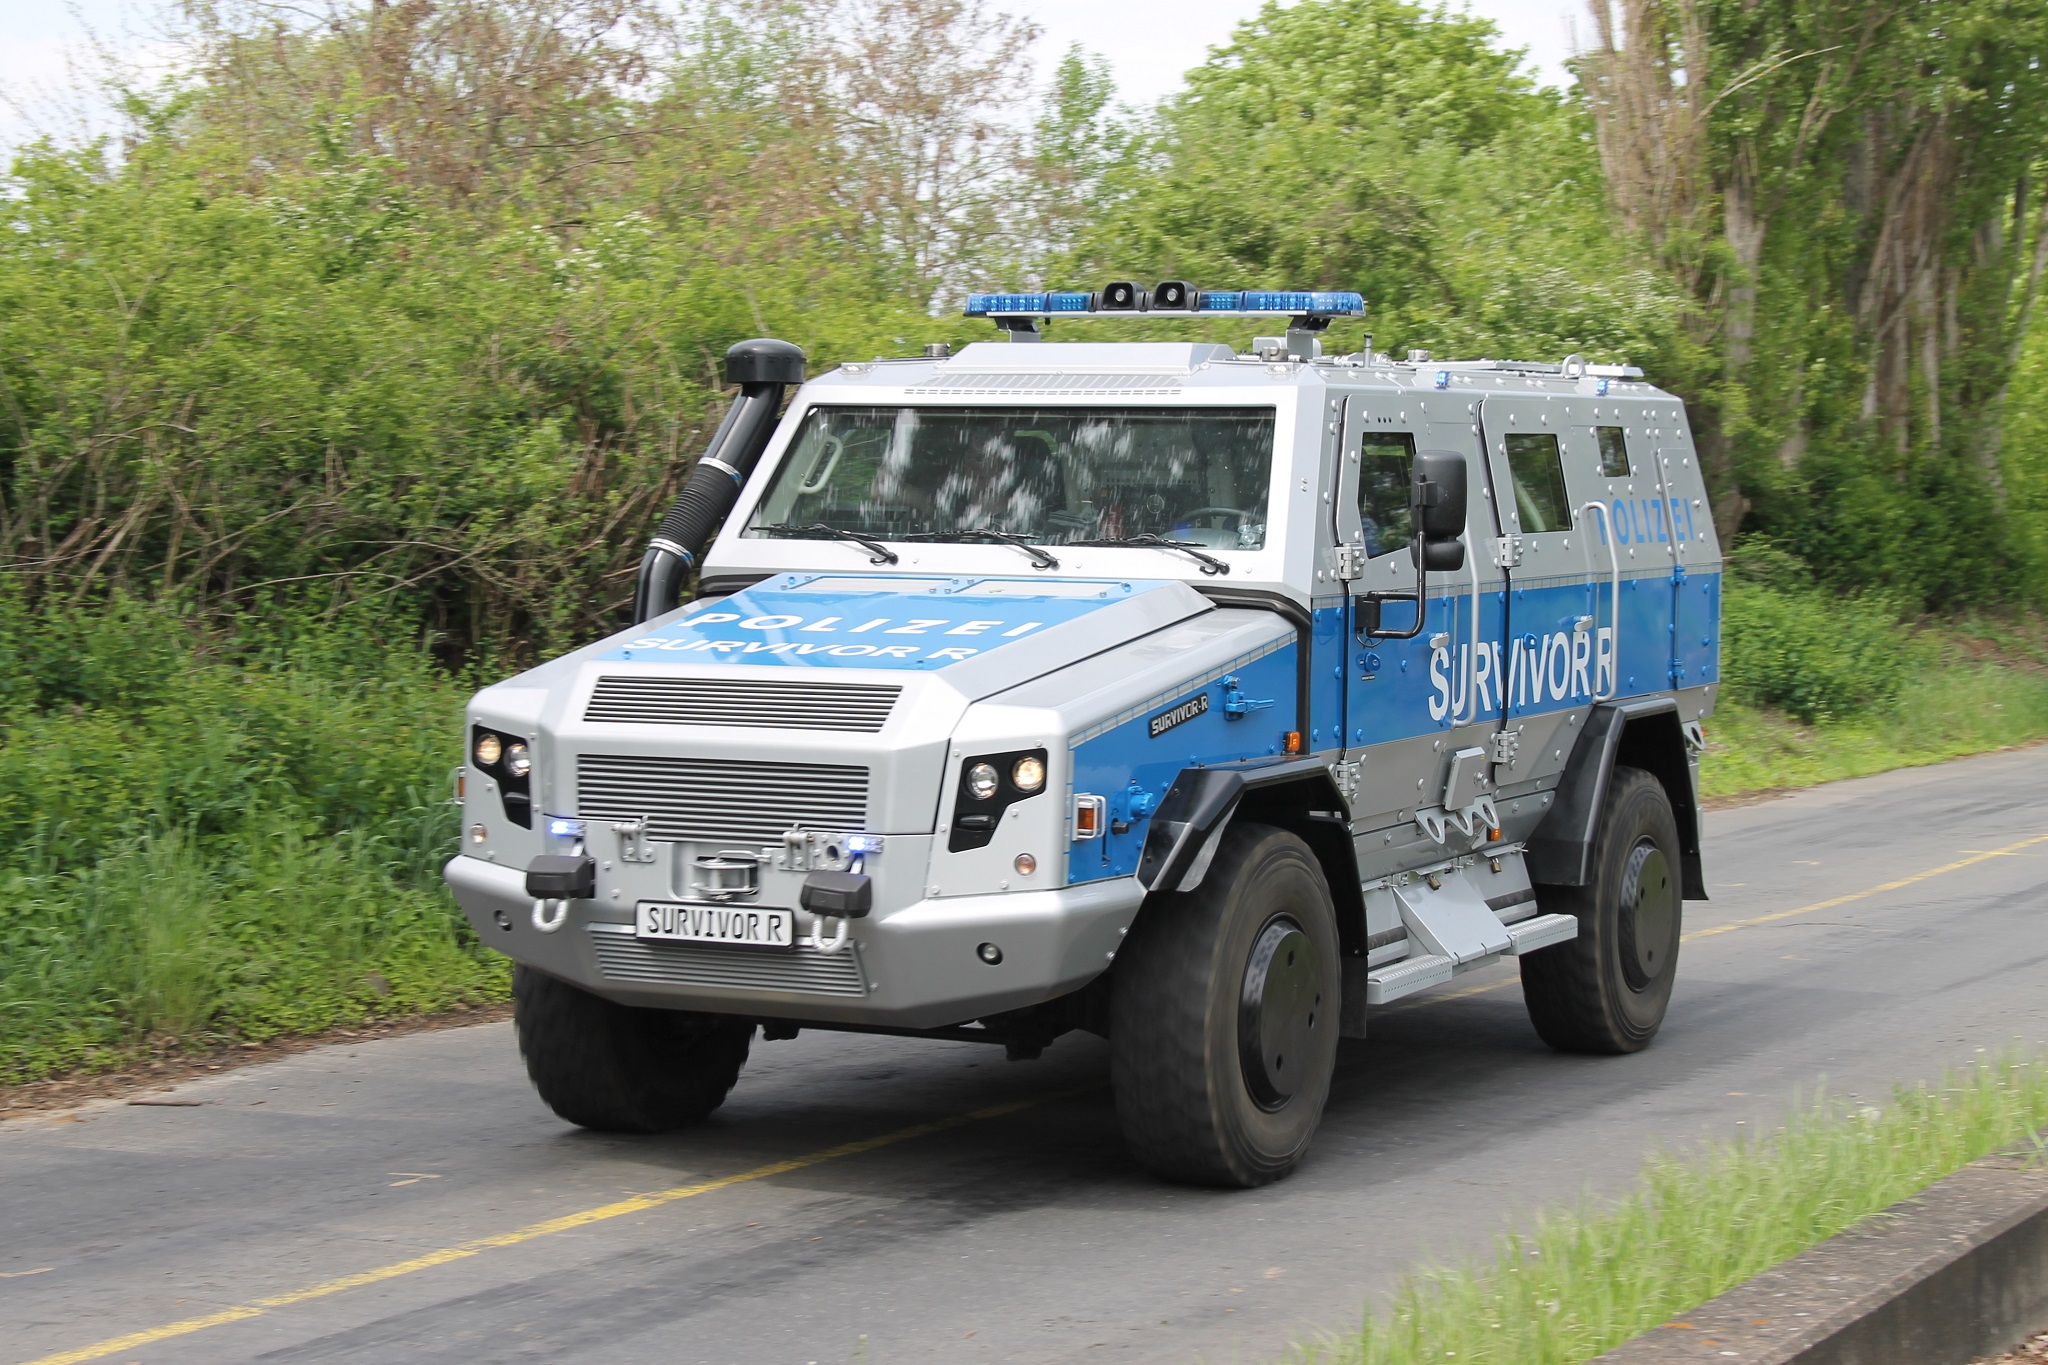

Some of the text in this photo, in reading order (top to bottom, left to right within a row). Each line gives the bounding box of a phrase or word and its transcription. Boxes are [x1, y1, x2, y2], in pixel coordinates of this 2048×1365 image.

[677, 612, 1044, 637] POLIZEI
[621, 637, 979, 660] SURVIVOR R
[1428, 626, 1613, 721] SURVIVOR R
[648, 907, 783, 942] SURVIVOR R
